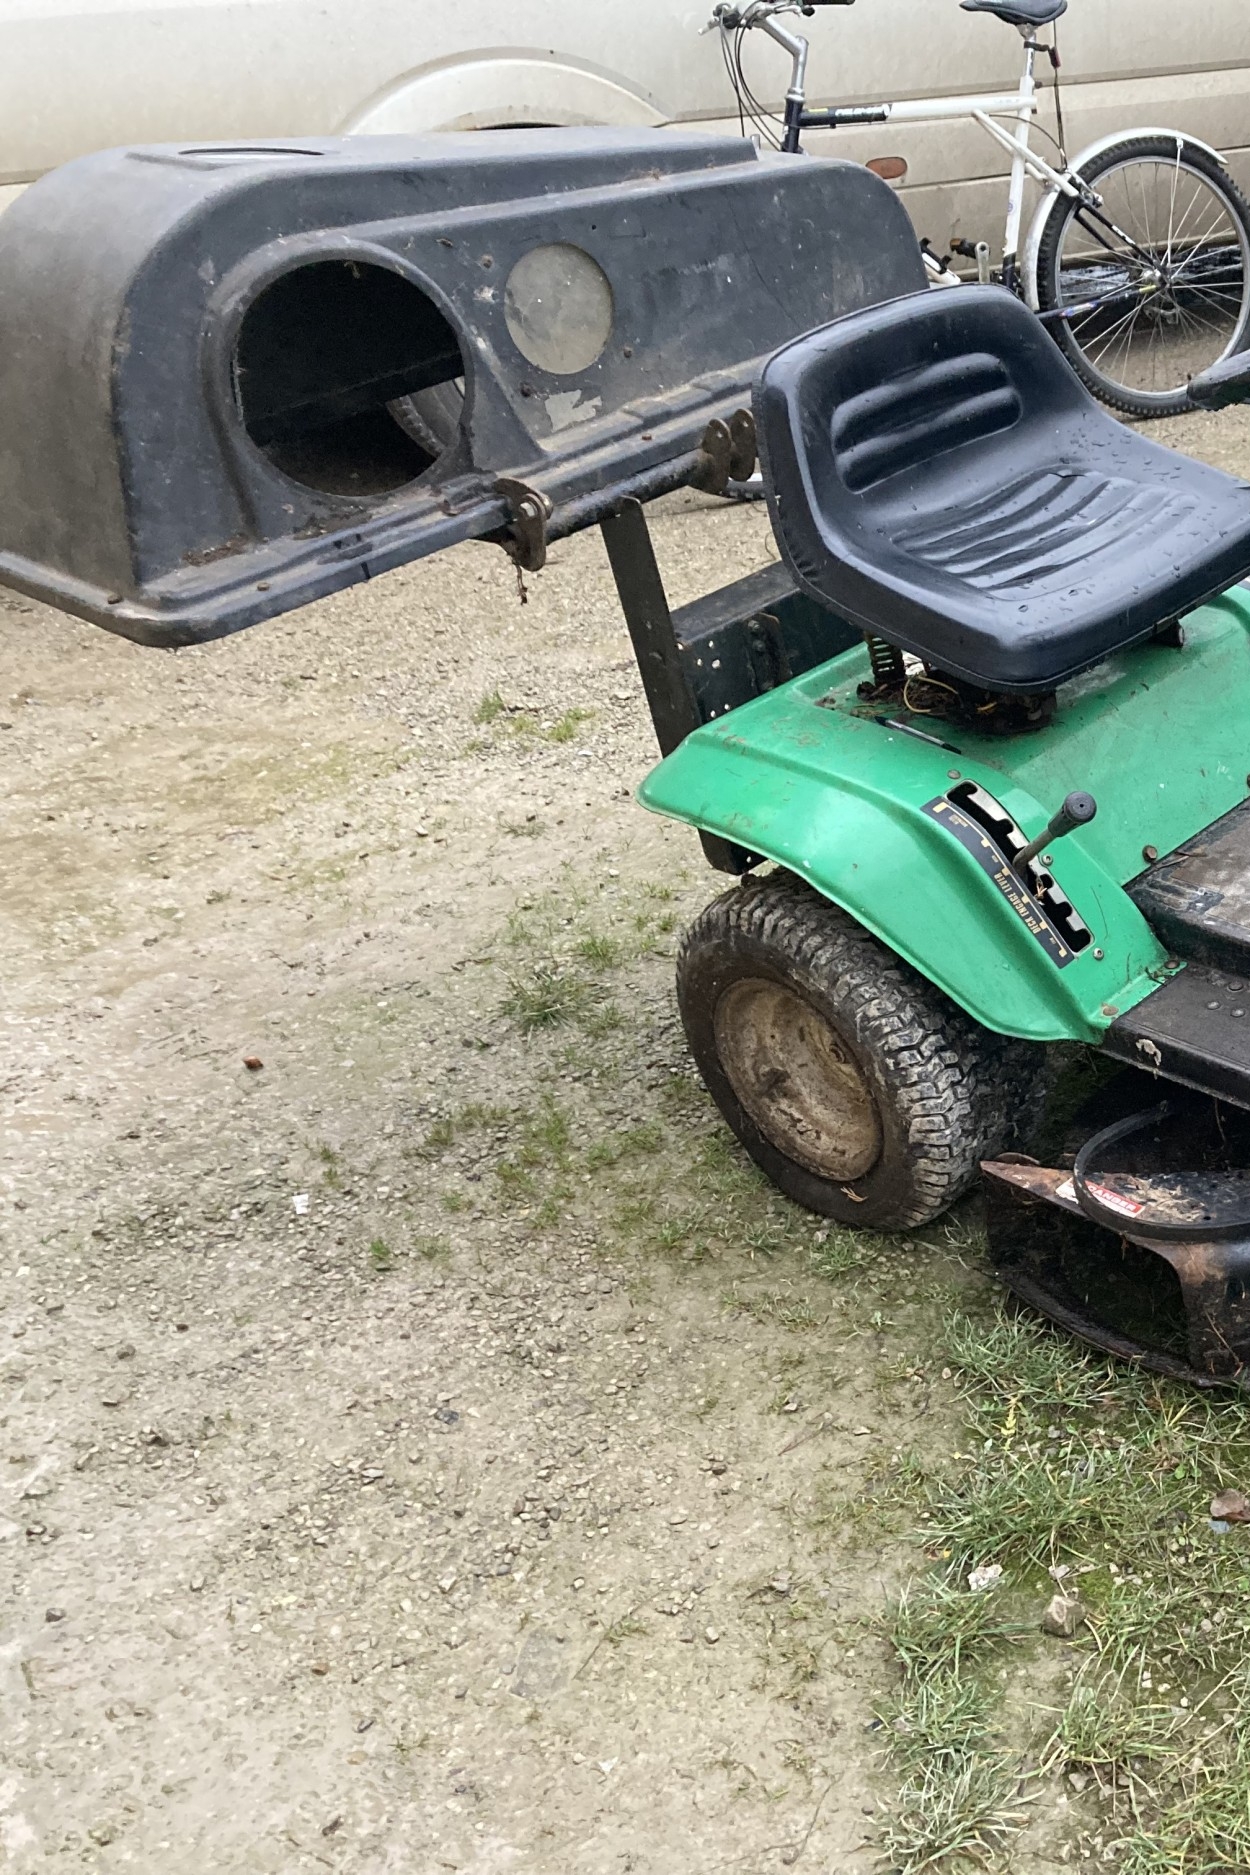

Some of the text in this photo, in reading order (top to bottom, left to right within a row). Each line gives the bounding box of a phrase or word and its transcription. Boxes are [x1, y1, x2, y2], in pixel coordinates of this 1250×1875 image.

[993, 871, 1042, 935] DECK ENGAGE LEVER
